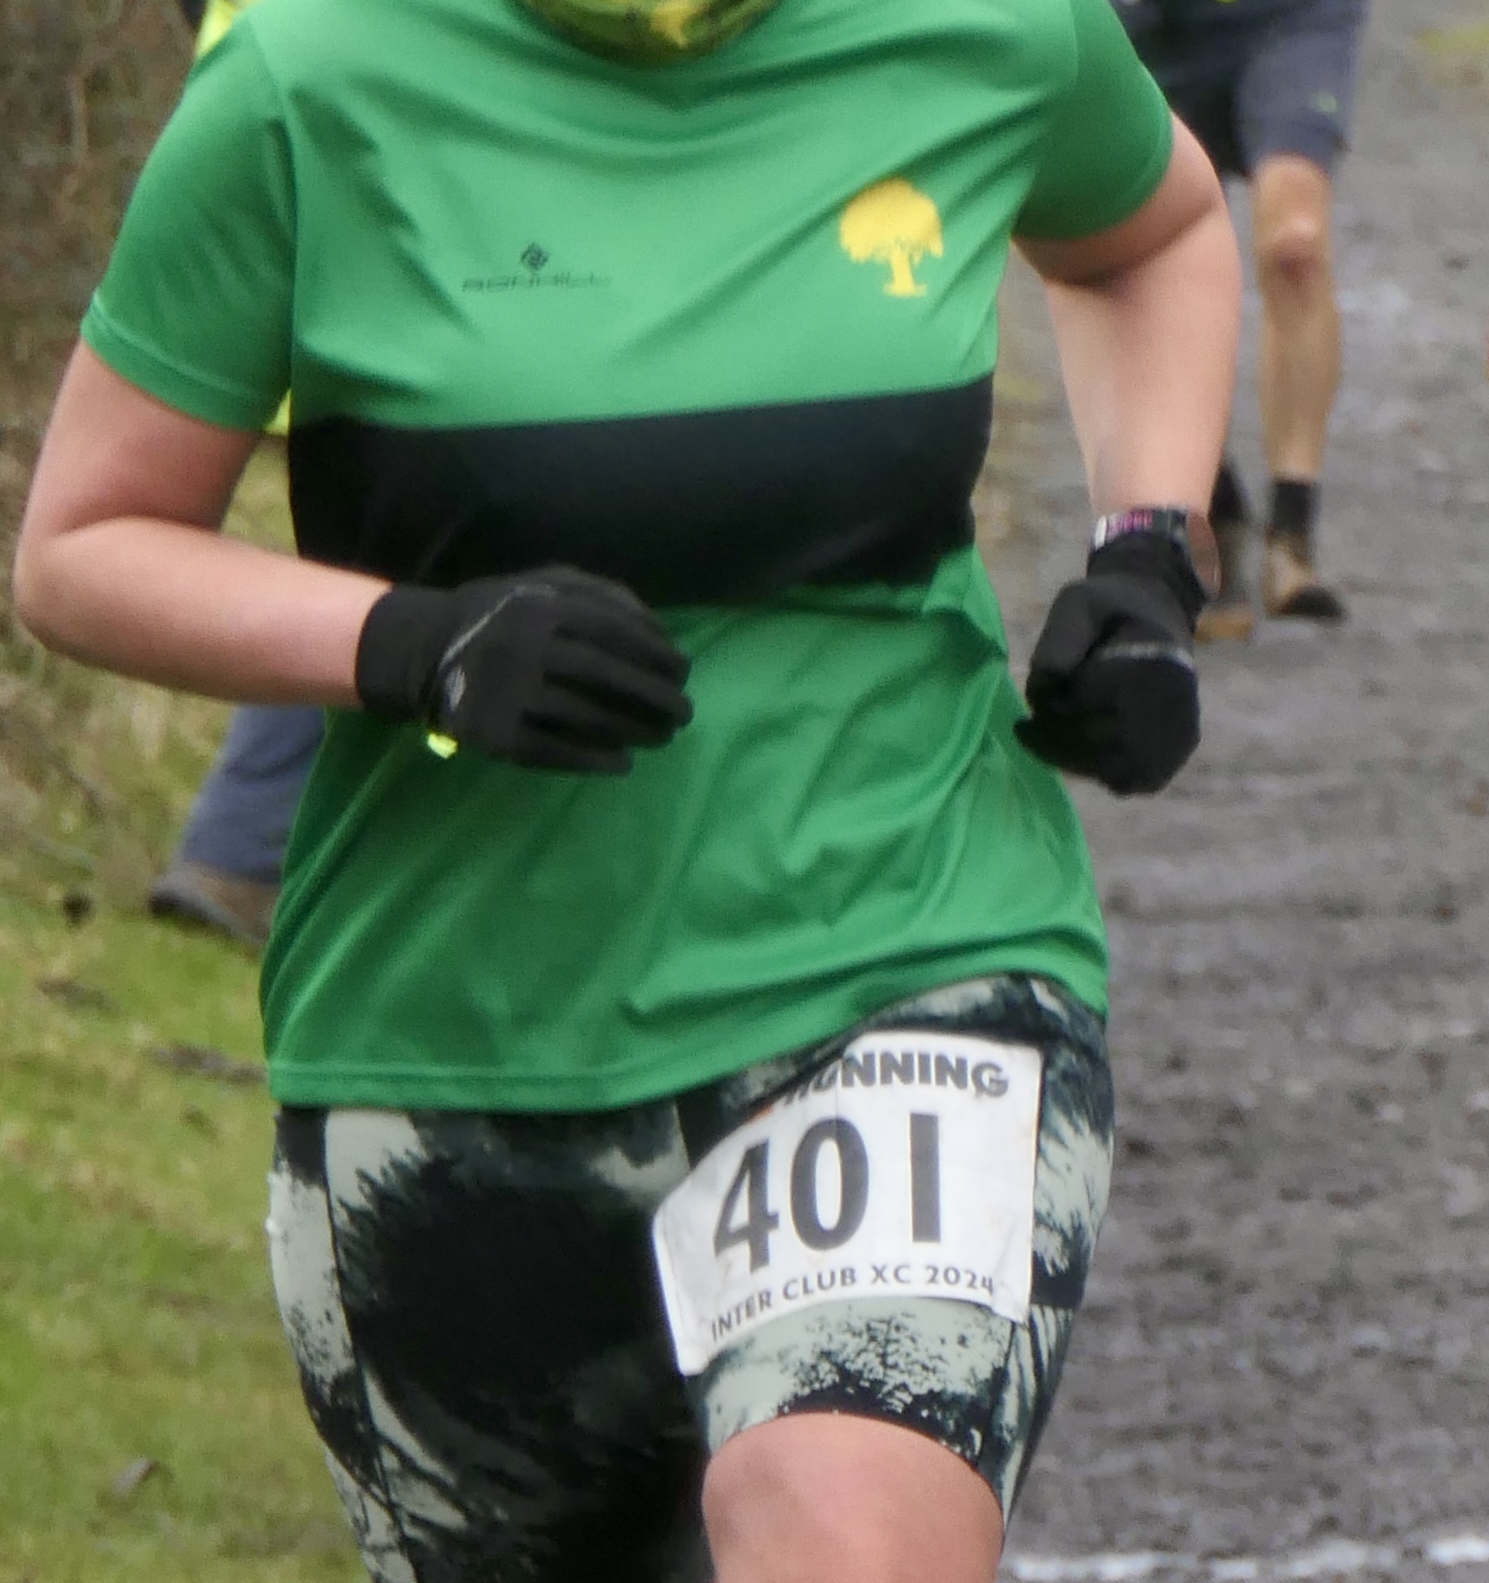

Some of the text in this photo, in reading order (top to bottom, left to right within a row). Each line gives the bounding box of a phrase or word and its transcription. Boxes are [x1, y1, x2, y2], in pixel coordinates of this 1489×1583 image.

[784, 1050, 1010, 1106] UNNING
[714, 1112, 942, 1273] 401
[710, 1263, 995, 1342] INTER CLUB XC 2024
